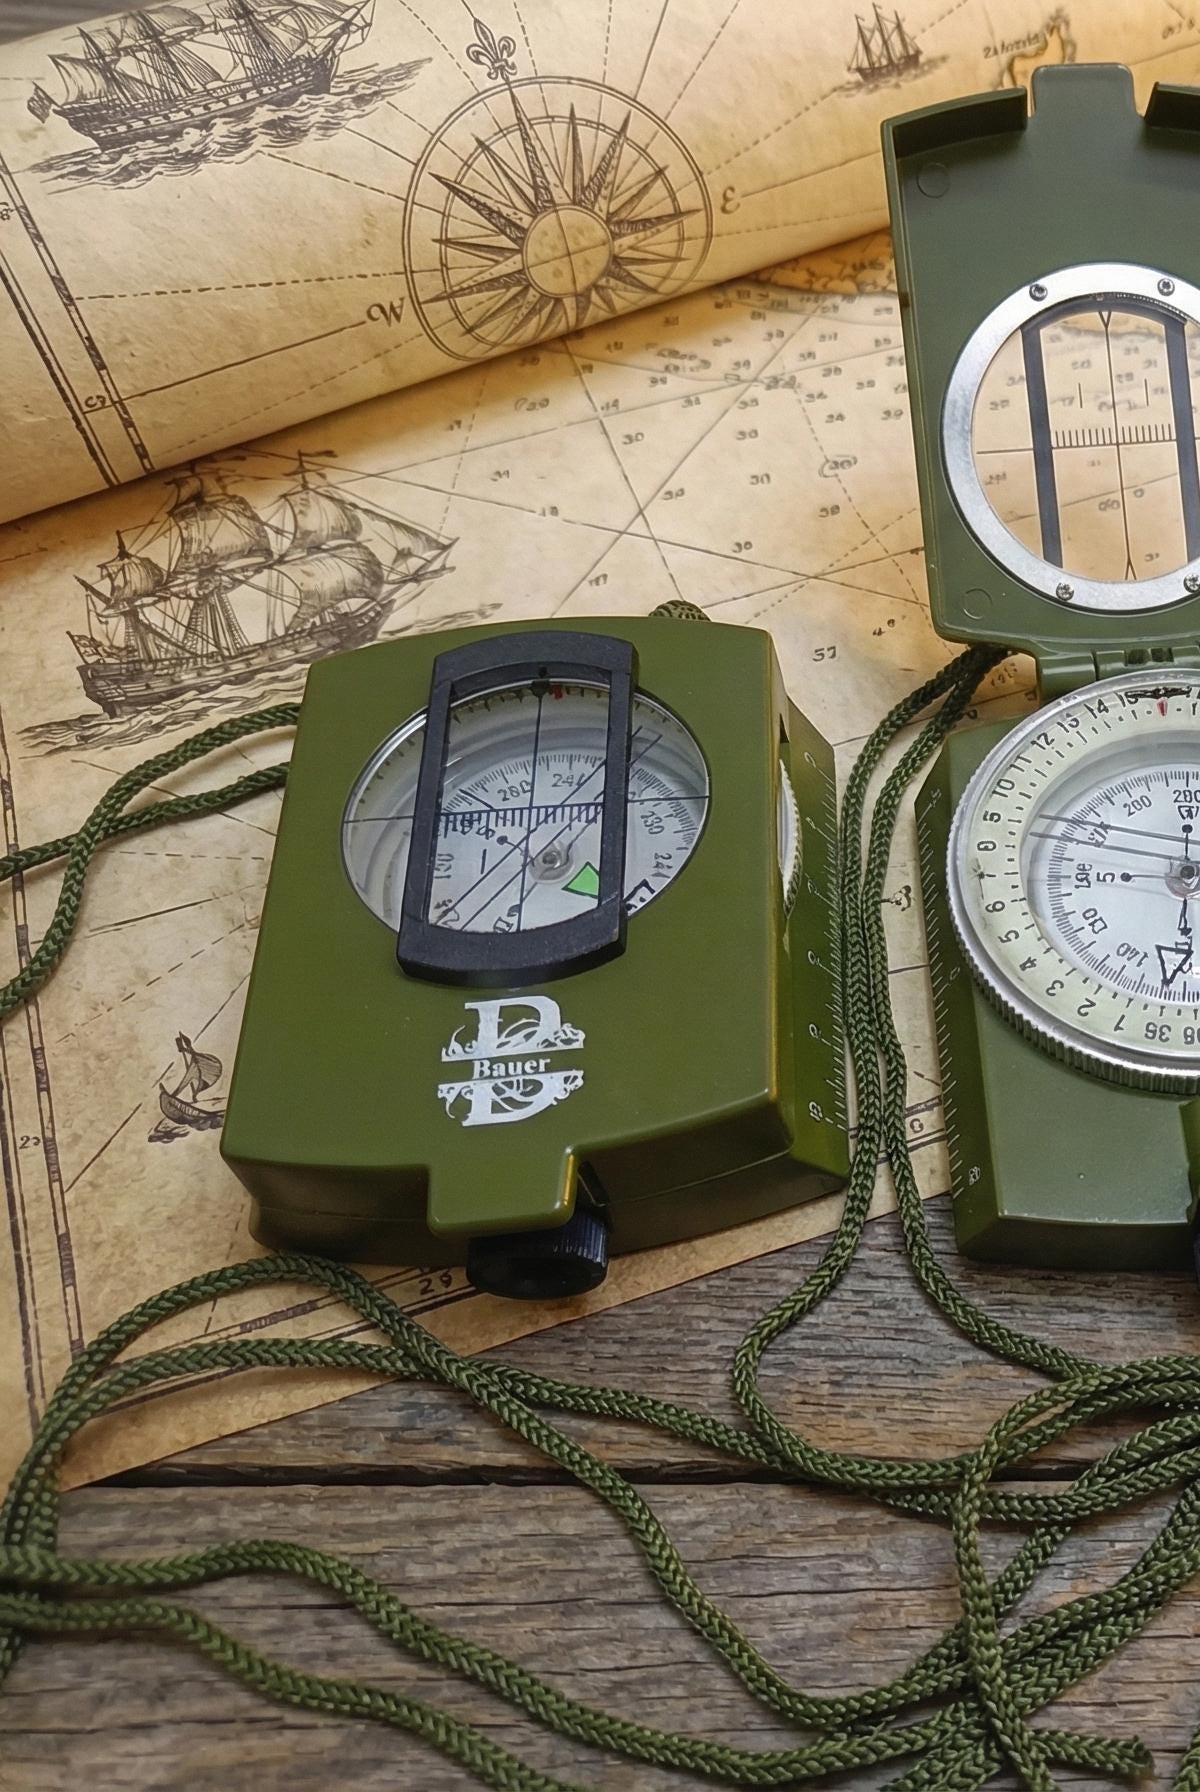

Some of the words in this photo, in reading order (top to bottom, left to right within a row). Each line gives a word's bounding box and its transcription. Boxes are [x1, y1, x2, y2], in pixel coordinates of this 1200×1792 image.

[1083, 698, 1110, 720] 14
[1030, 731, 1056, 751] 12
[1008, 755, 1033, 774] 11
[991, 777, 1016, 799] 10
[1096, 871, 1116, 884] 5
[984, 899, 1006, 914] 6
[997, 928, 1021, 944] 5
[1045, 979, 1065, 997] 3
[1076, 997, 1097, 1018] 2
[1113, 1014, 1127, 1033] 1
[472, 1058, 551, 1080] Bauer
